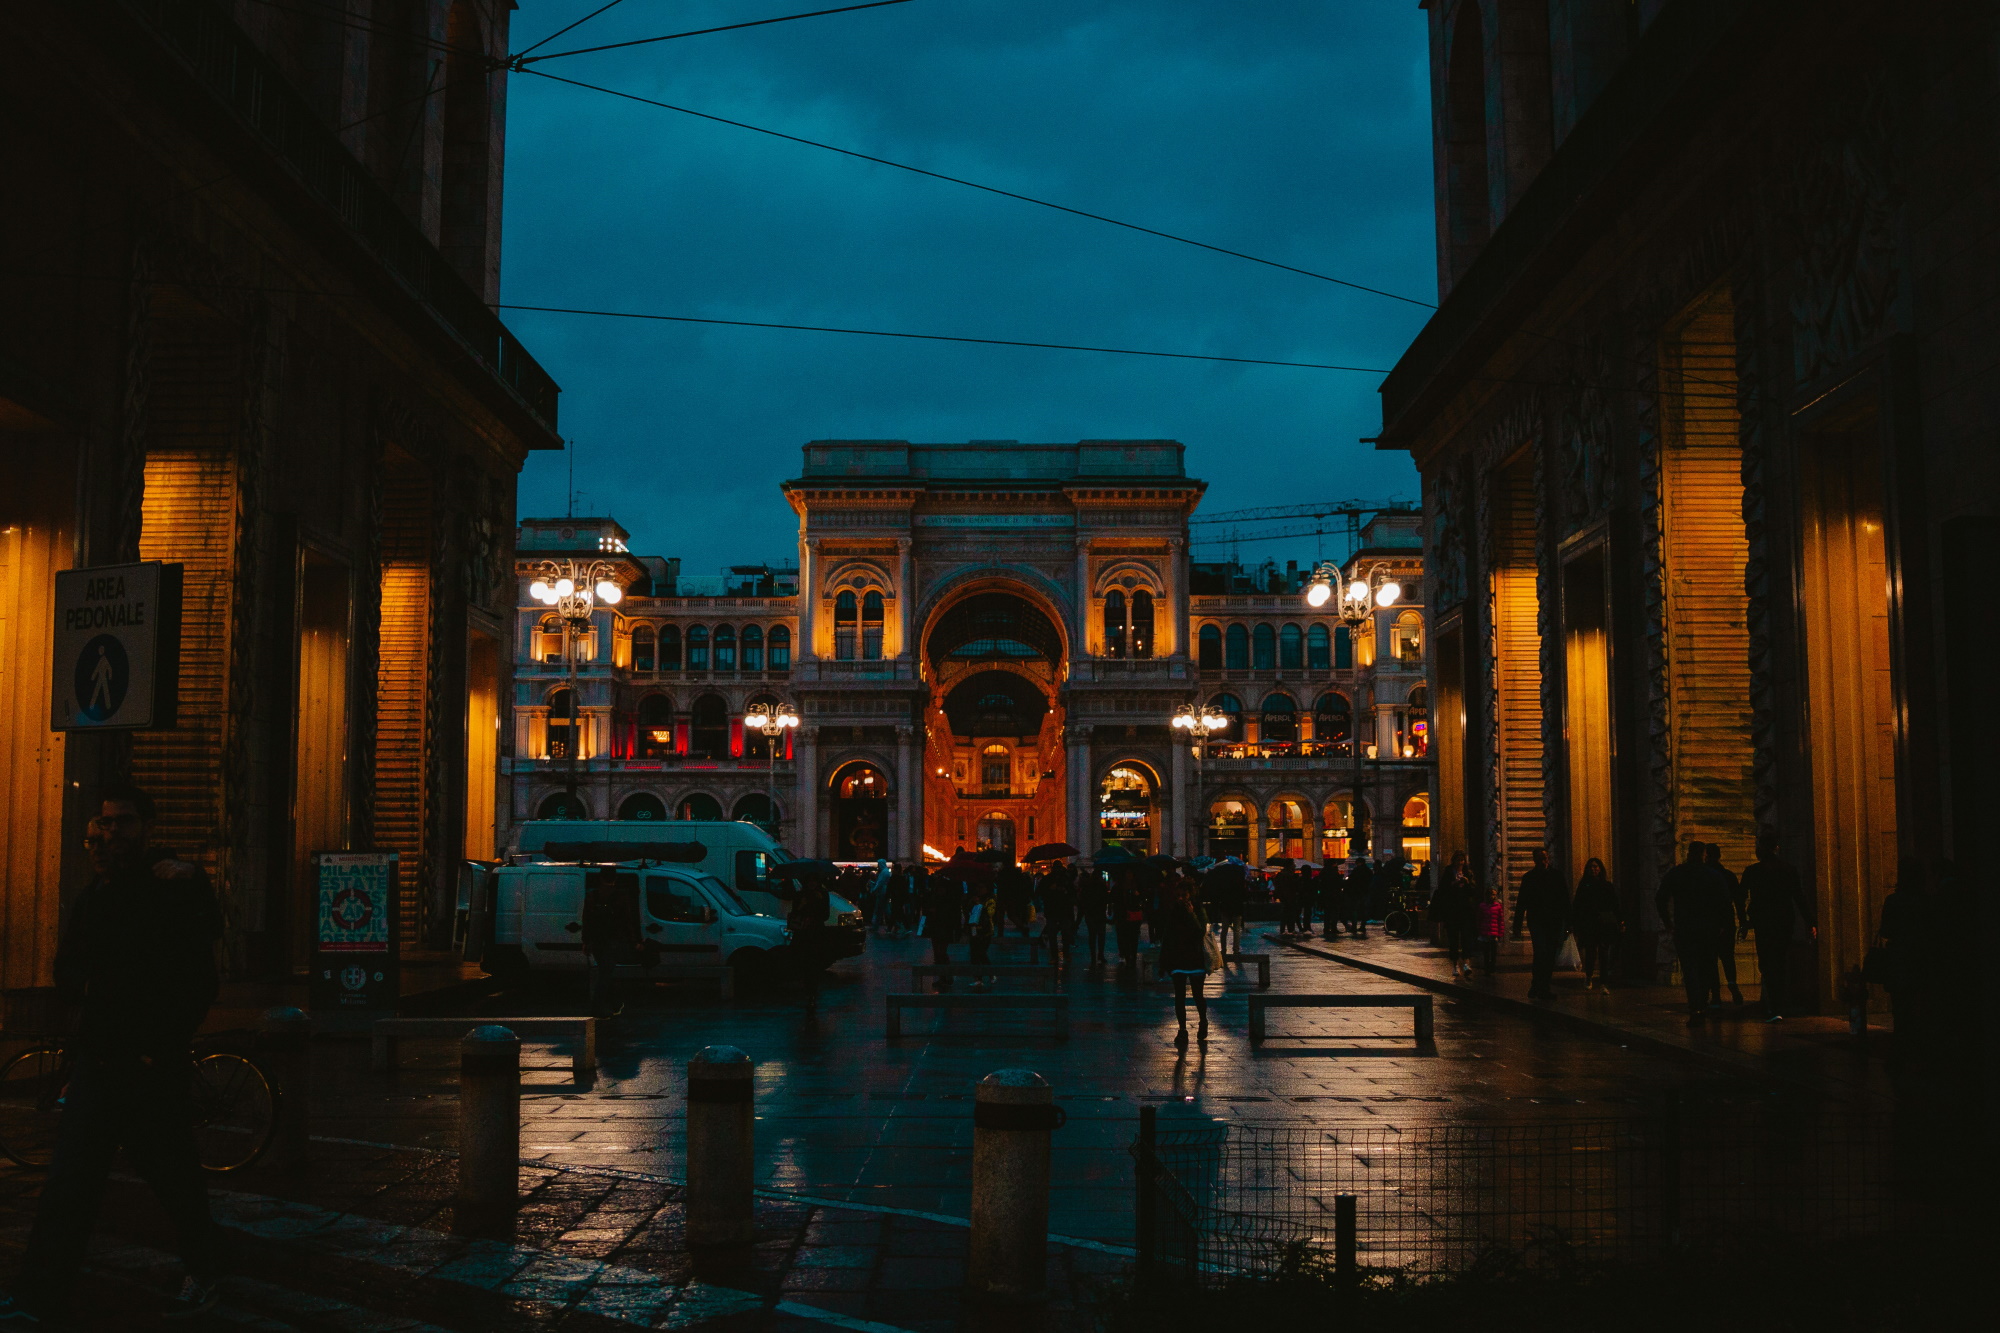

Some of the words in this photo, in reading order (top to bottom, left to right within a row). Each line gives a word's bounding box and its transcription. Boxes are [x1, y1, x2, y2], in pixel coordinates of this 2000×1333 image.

[85, 576, 126, 602] AREA
[66, 602, 144, 630] PEDONALE
[1264, 713, 1291, 722] APEROL
[1318, 713, 1345, 722] APEROL
[320, 865, 386, 876] MILANO
[320, 877, 386, 890] ESTATE
